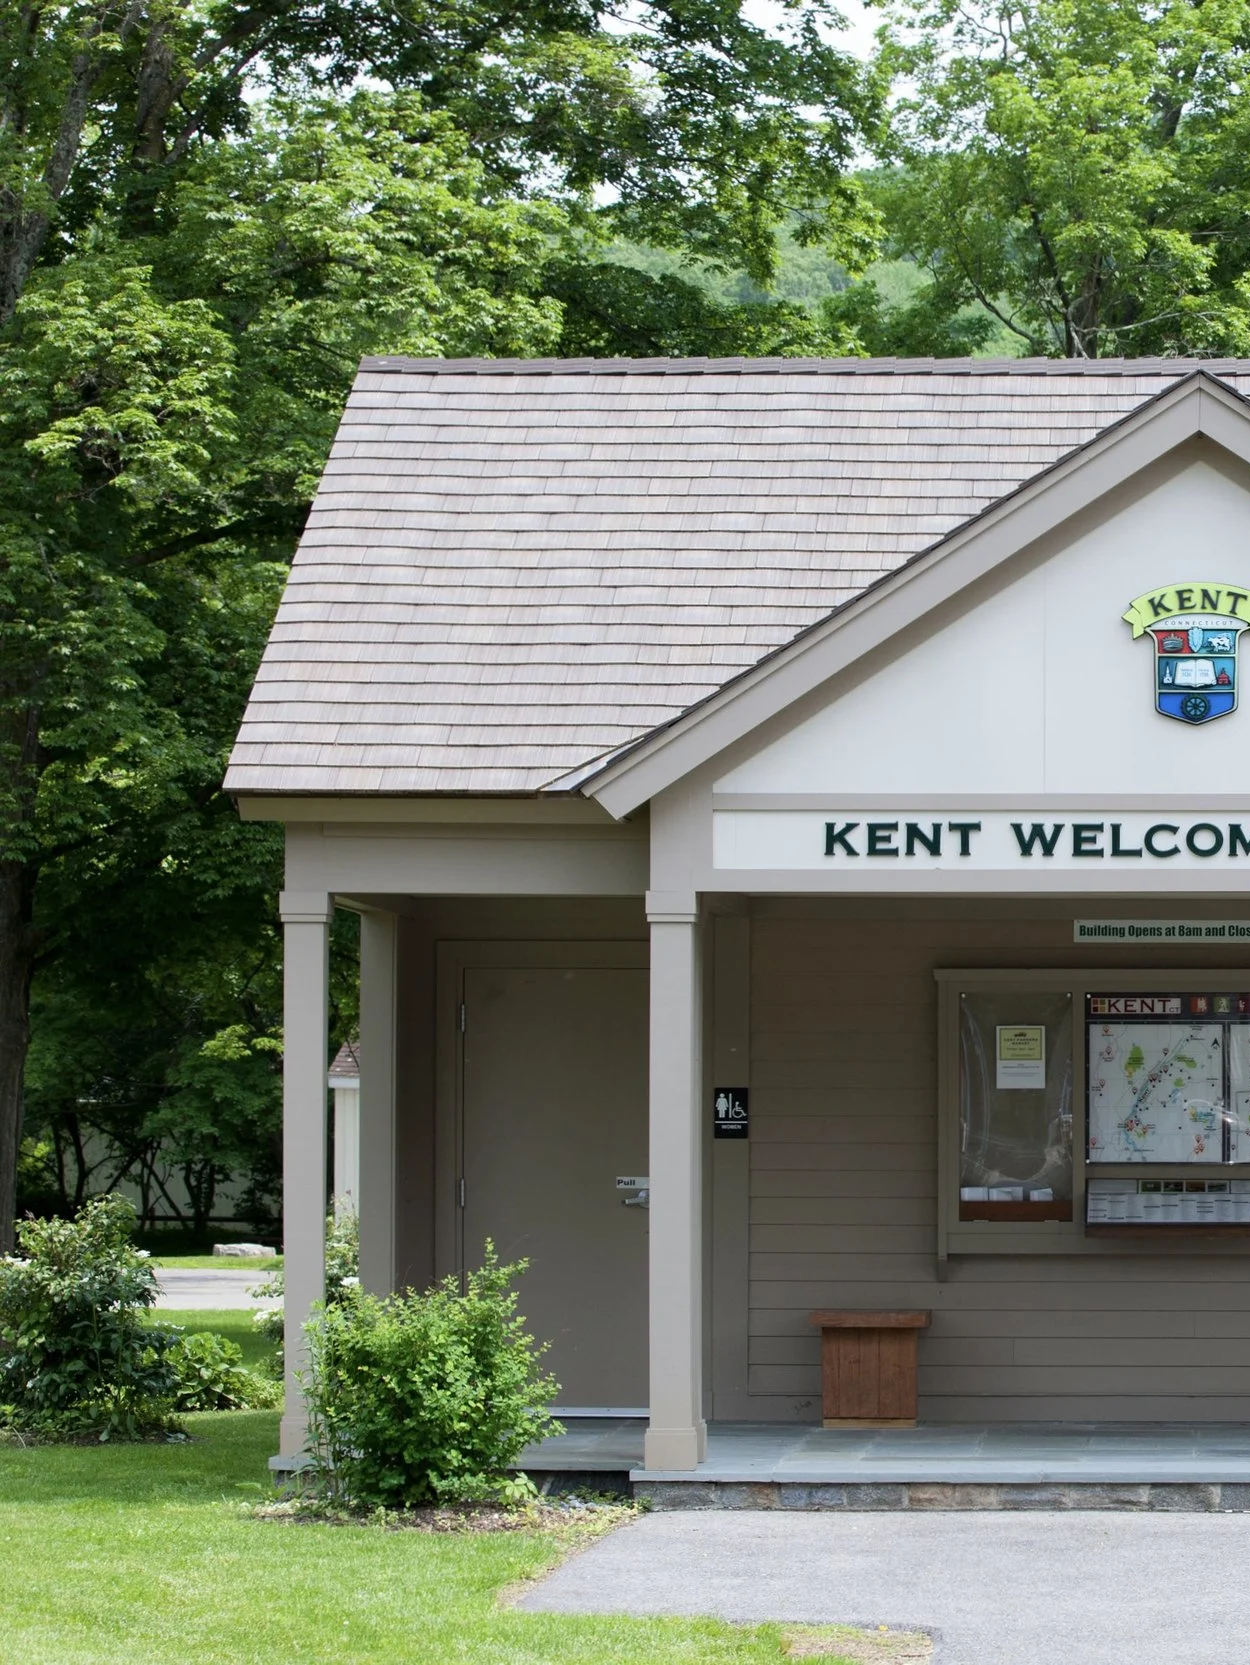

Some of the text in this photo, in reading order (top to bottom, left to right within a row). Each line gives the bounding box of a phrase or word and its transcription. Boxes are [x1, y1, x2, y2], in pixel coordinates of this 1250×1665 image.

[1147, 588, 1248, 617] KENT
[823, 820, 982, 857] KENT
[1079, 925, 1126, 937] Building
[1128, 925, 1163, 937] Opens
[1165, 926, 1176, 937] at
[1178, 925, 1202, 936] 8am
[1205, 925, 1226, 936] and
[1107, 999, 1171, 1013] KENT
